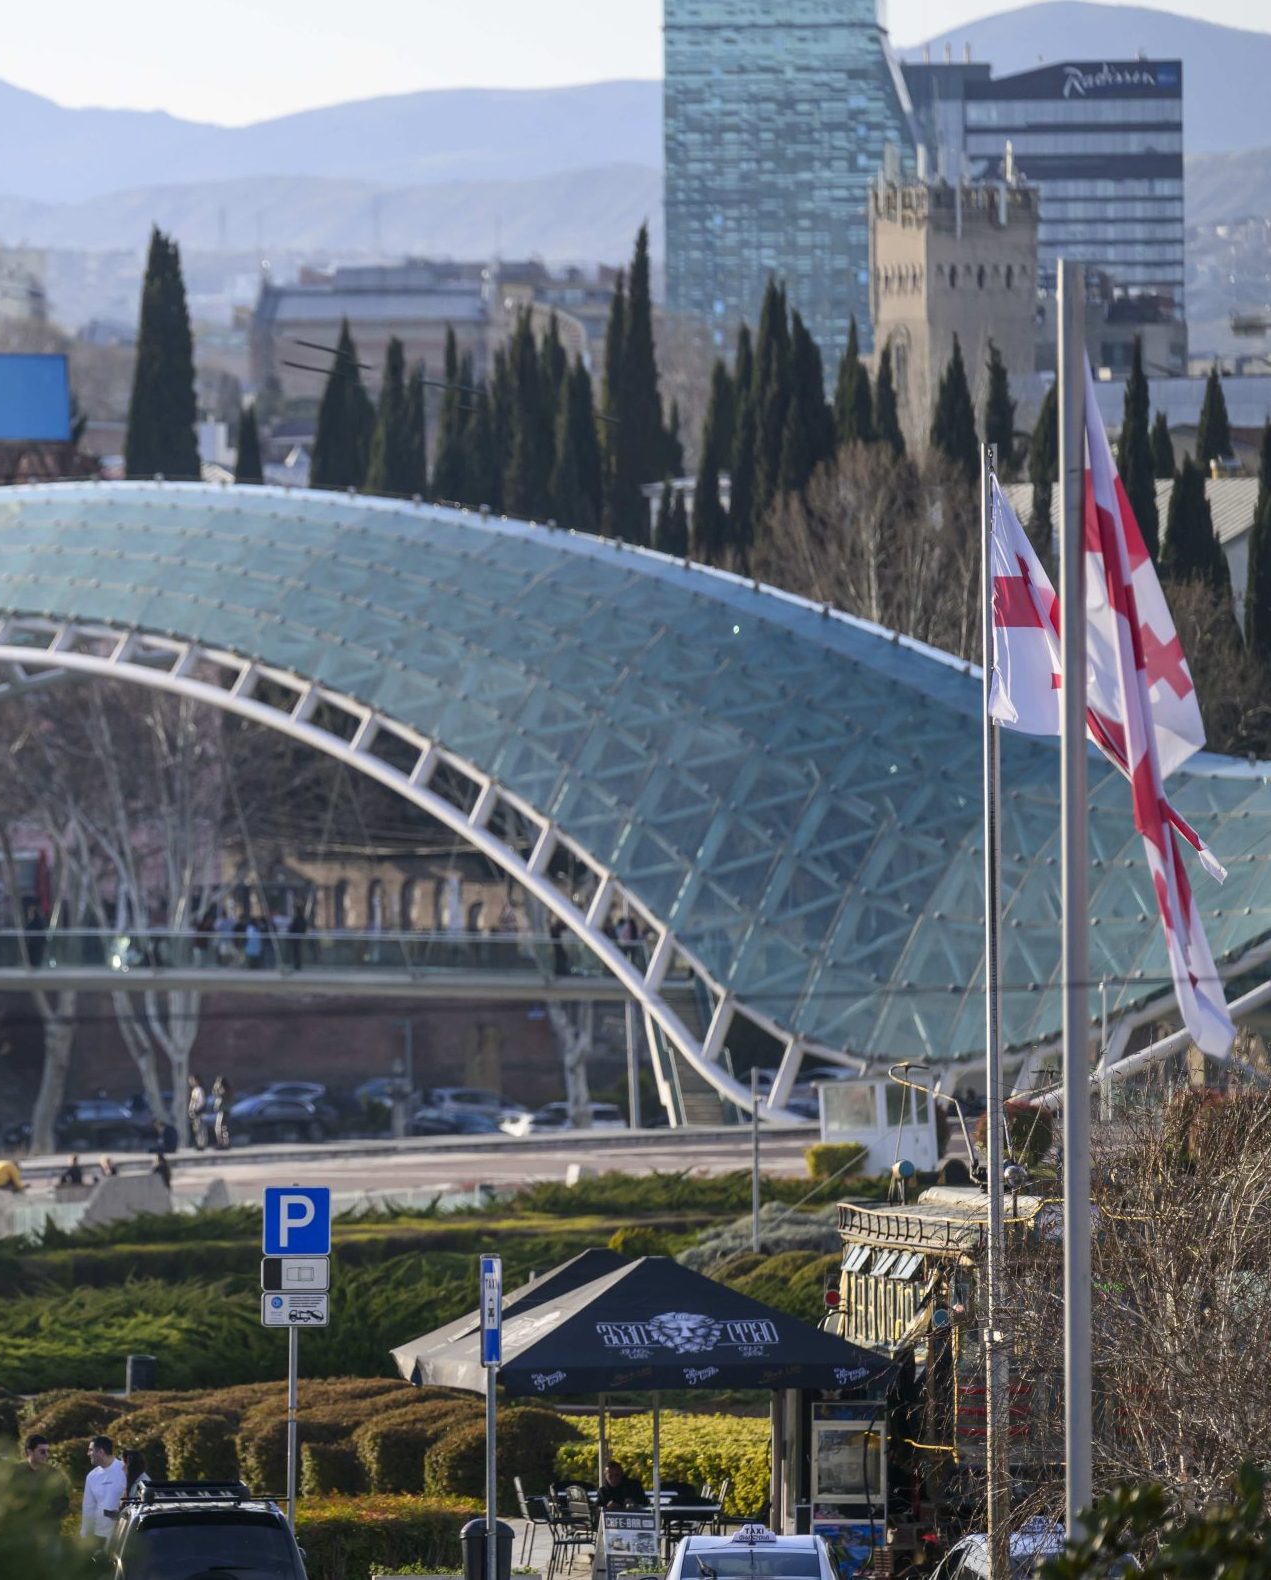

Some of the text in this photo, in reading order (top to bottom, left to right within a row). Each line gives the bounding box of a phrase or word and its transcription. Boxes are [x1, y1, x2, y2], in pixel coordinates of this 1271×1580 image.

[1063, 62, 1156, 98] Radisson
[279, 1195, 316, 1248] P
[605, 1517, 642, 1529] CAFE-BAR
[744, 1527, 765, 1535] TAXI
